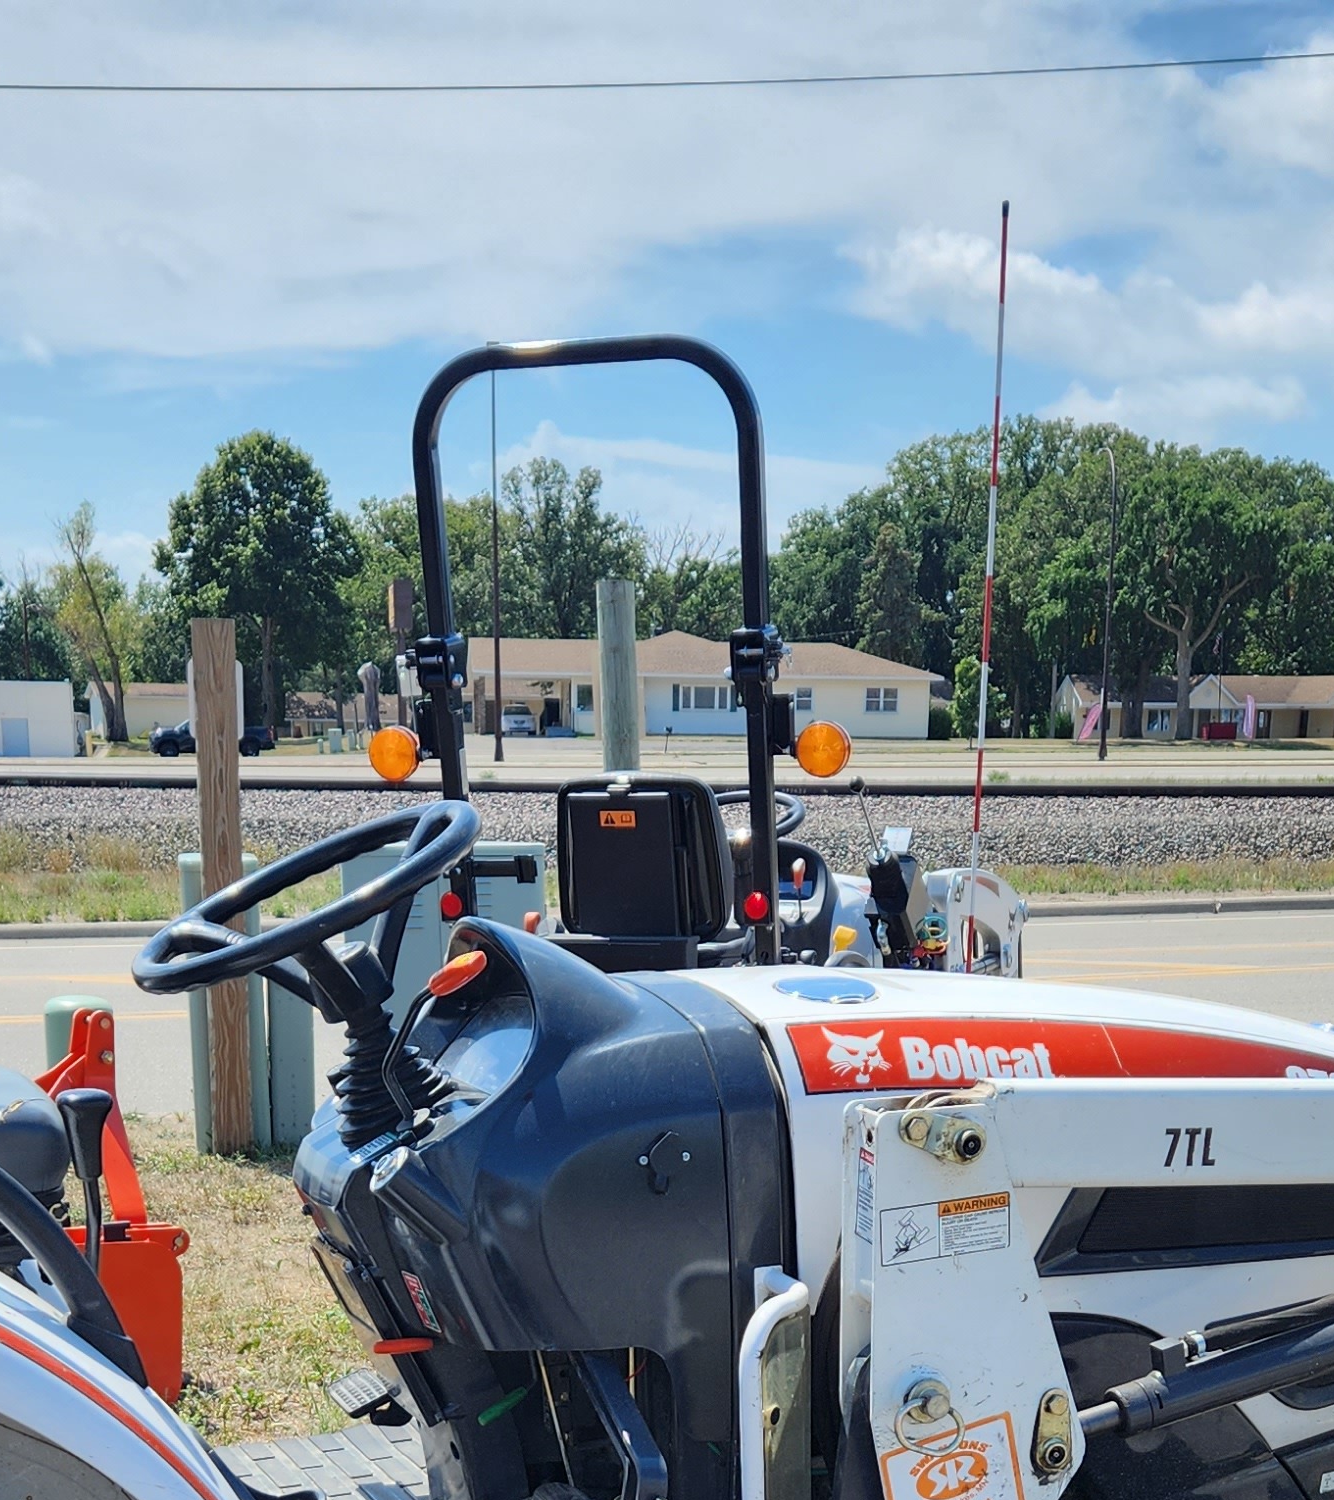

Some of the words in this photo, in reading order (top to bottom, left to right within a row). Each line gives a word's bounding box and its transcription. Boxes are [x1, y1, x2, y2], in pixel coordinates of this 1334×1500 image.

[899, 1036, 1056, 1079] Bobcat
[1164, 1127, 1216, 1168] 7TL
[952, 1196, 1006, 1212] WARNING
[975, 1479, 989, 1493] MN
